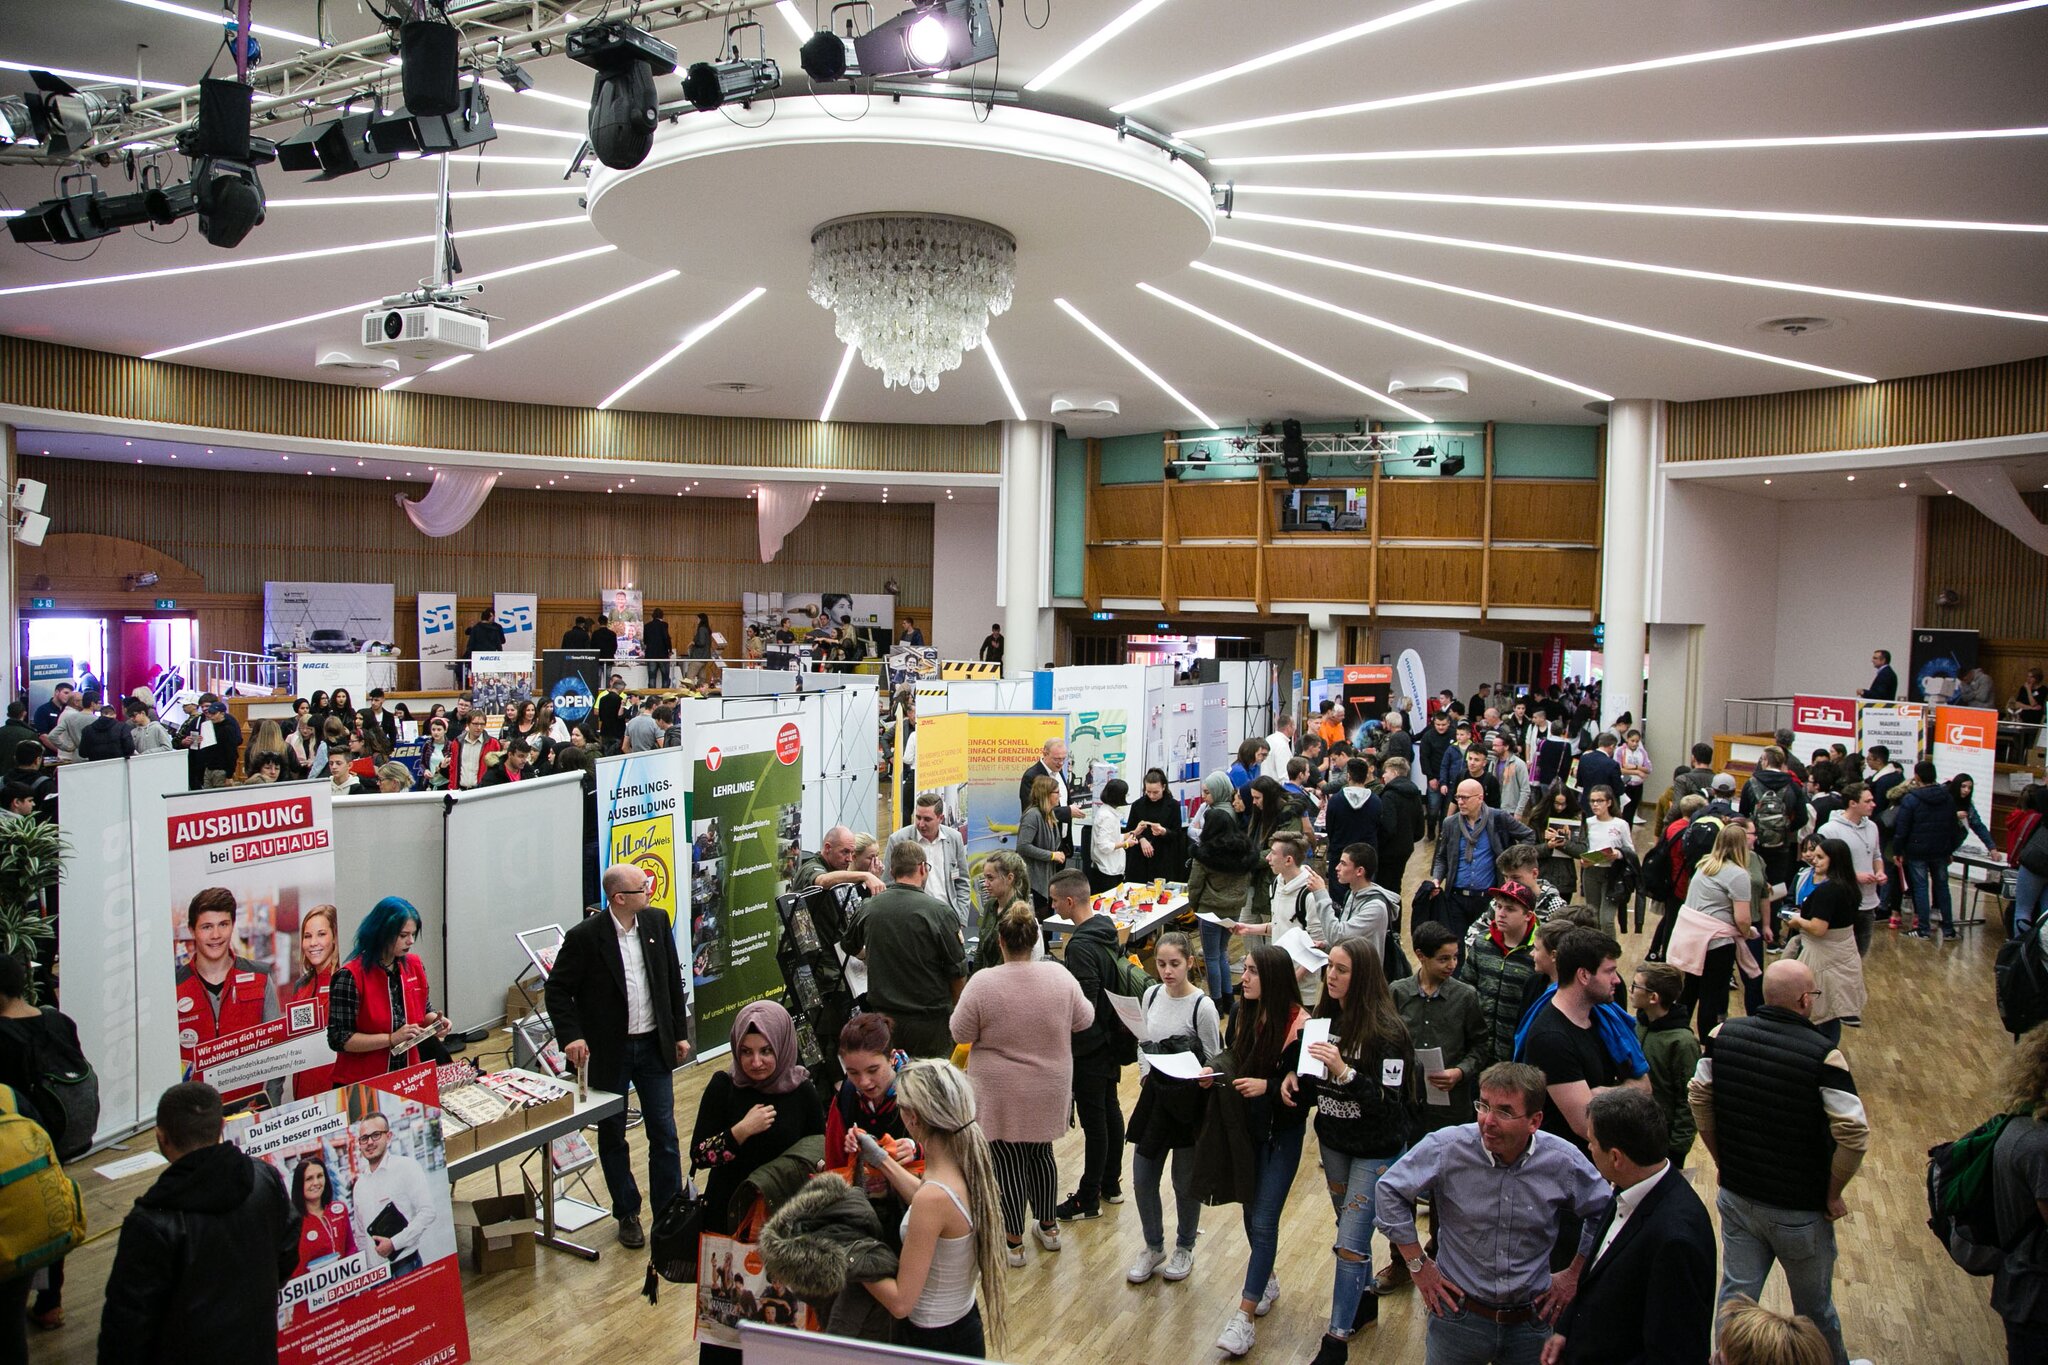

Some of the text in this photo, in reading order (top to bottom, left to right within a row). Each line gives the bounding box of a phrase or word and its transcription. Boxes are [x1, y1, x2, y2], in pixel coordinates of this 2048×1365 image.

[554, 696, 592, 708] OPEN
[610, 779, 672, 800] LEHRLINGS-
[713, 780, 755, 797] LEHRLINGE
[607, 798, 676, 822] AUSBILDUNG
[176, 804, 304, 844] AUSBILDUNG
[733, 831, 758, 842] Ausbildung
[210, 831, 328, 864] bei BAUHAUS
[655, 837, 670, 846] Wels
[731, 901, 768, 917] Faire Bezahlung
[731, 934, 757, 948] Übernahme
[731, 955, 750, 967] möglich
[711, 1006, 725, 1018] unser
[725, 1002, 737, 1013] Heer
[765, 985, 783, 997] Gerade
[198, 1023, 283, 1057] Wir suchen dich für eine
[198, 1038, 273, 1068] Ausbildung zum/zur:
[217, 1048, 303, 1077] Einzelhandelskaufmann/-frau
[217, 1058, 306, 1088] Betriebslogistikkaufmann/-frau
[393, 1082, 401, 1091] ab
[407, 1067, 432, 1086] Lehrjahr
[419, 1080, 425, 1088] €
[250, 1105, 322, 1139] Du bist das GUT,
[245, 1117, 343, 1156] das uns besser macht.
[312, 1296, 326, 1307] bei
[327, 1267, 388, 1301] BAUHAUS
[301, 1304, 396, 1354] Einzelhandelskaufmann/-frau
[316, 1328, 324, 1336] bei
[324, 1319, 346, 1332] BAUHAUS
[316, 1304, 416, 1355] Betriebslogistikkaufmann/-frau
